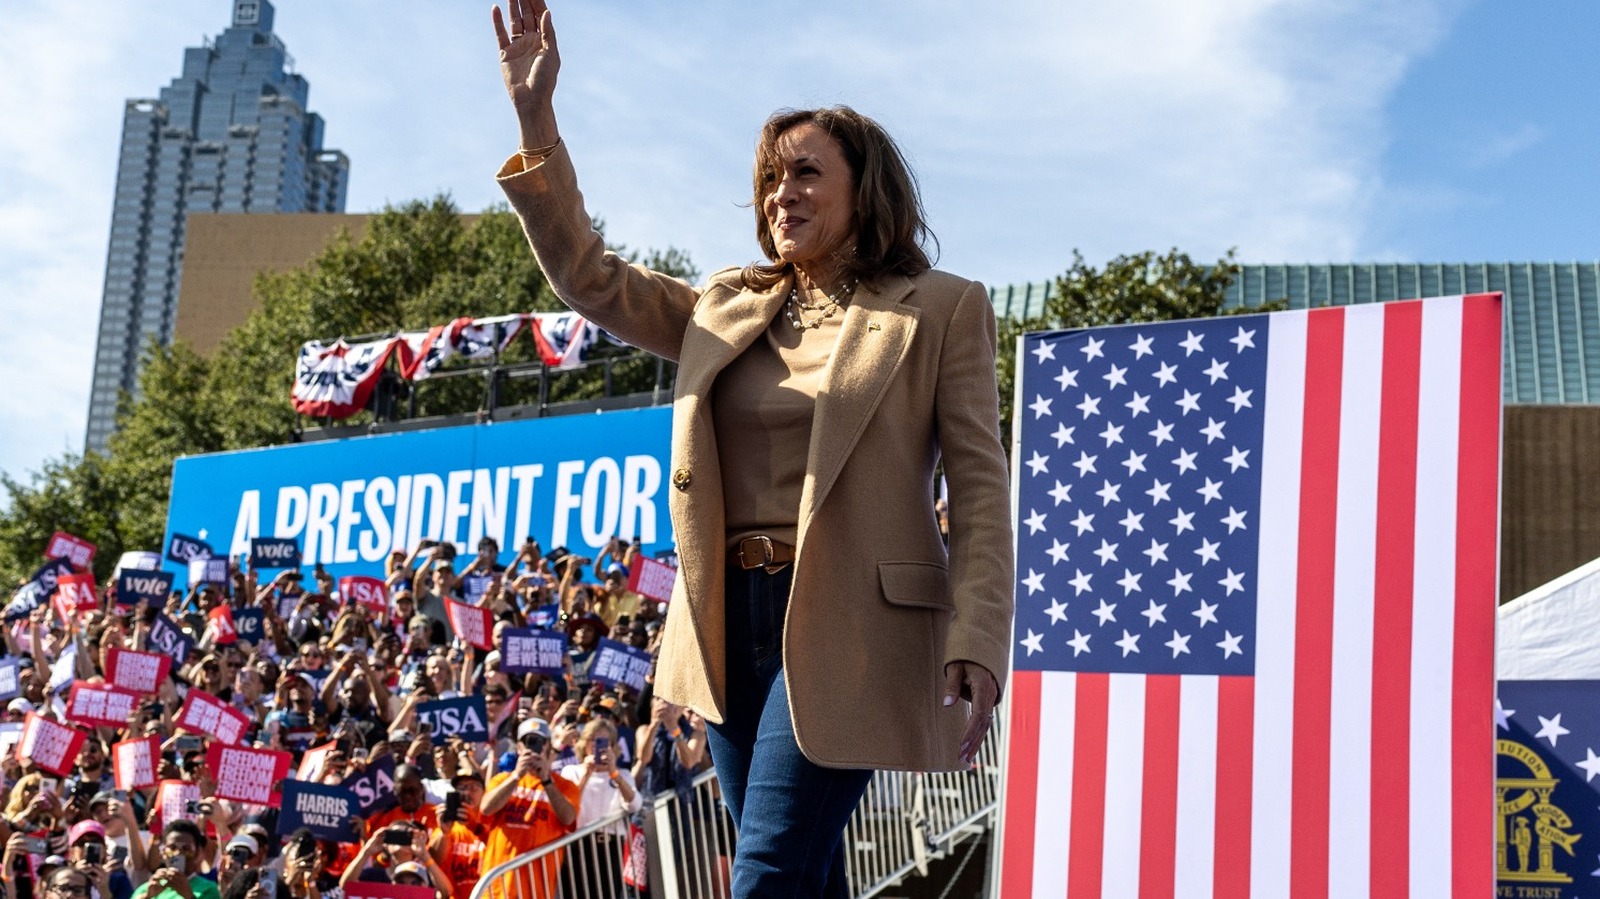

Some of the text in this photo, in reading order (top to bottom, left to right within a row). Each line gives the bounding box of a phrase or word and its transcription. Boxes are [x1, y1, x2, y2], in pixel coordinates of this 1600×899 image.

[230, 455, 661, 565] A PRESIDENT FOR
[171, 538, 212, 561] USA
[256, 541, 295, 559] vote
[124, 576, 168, 596] vote
[341, 582, 386, 605] USA
[151, 619, 186, 663] USA
[521, 637, 562, 653] WE VOTE
[520, 650, 538, 667] WE
[419, 706, 486, 738] USA
[221, 748, 277, 771] FREEDOM
[218, 763, 274, 786] FREEDOM
[215, 779, 271, 803] FREEDOM
[349, 769, 395, 807] SA
[296, 792, 349, 817] HARRIS
[302, 813, 340, 828] WALZ
[1516, 886, 1562, 898] TRUST
